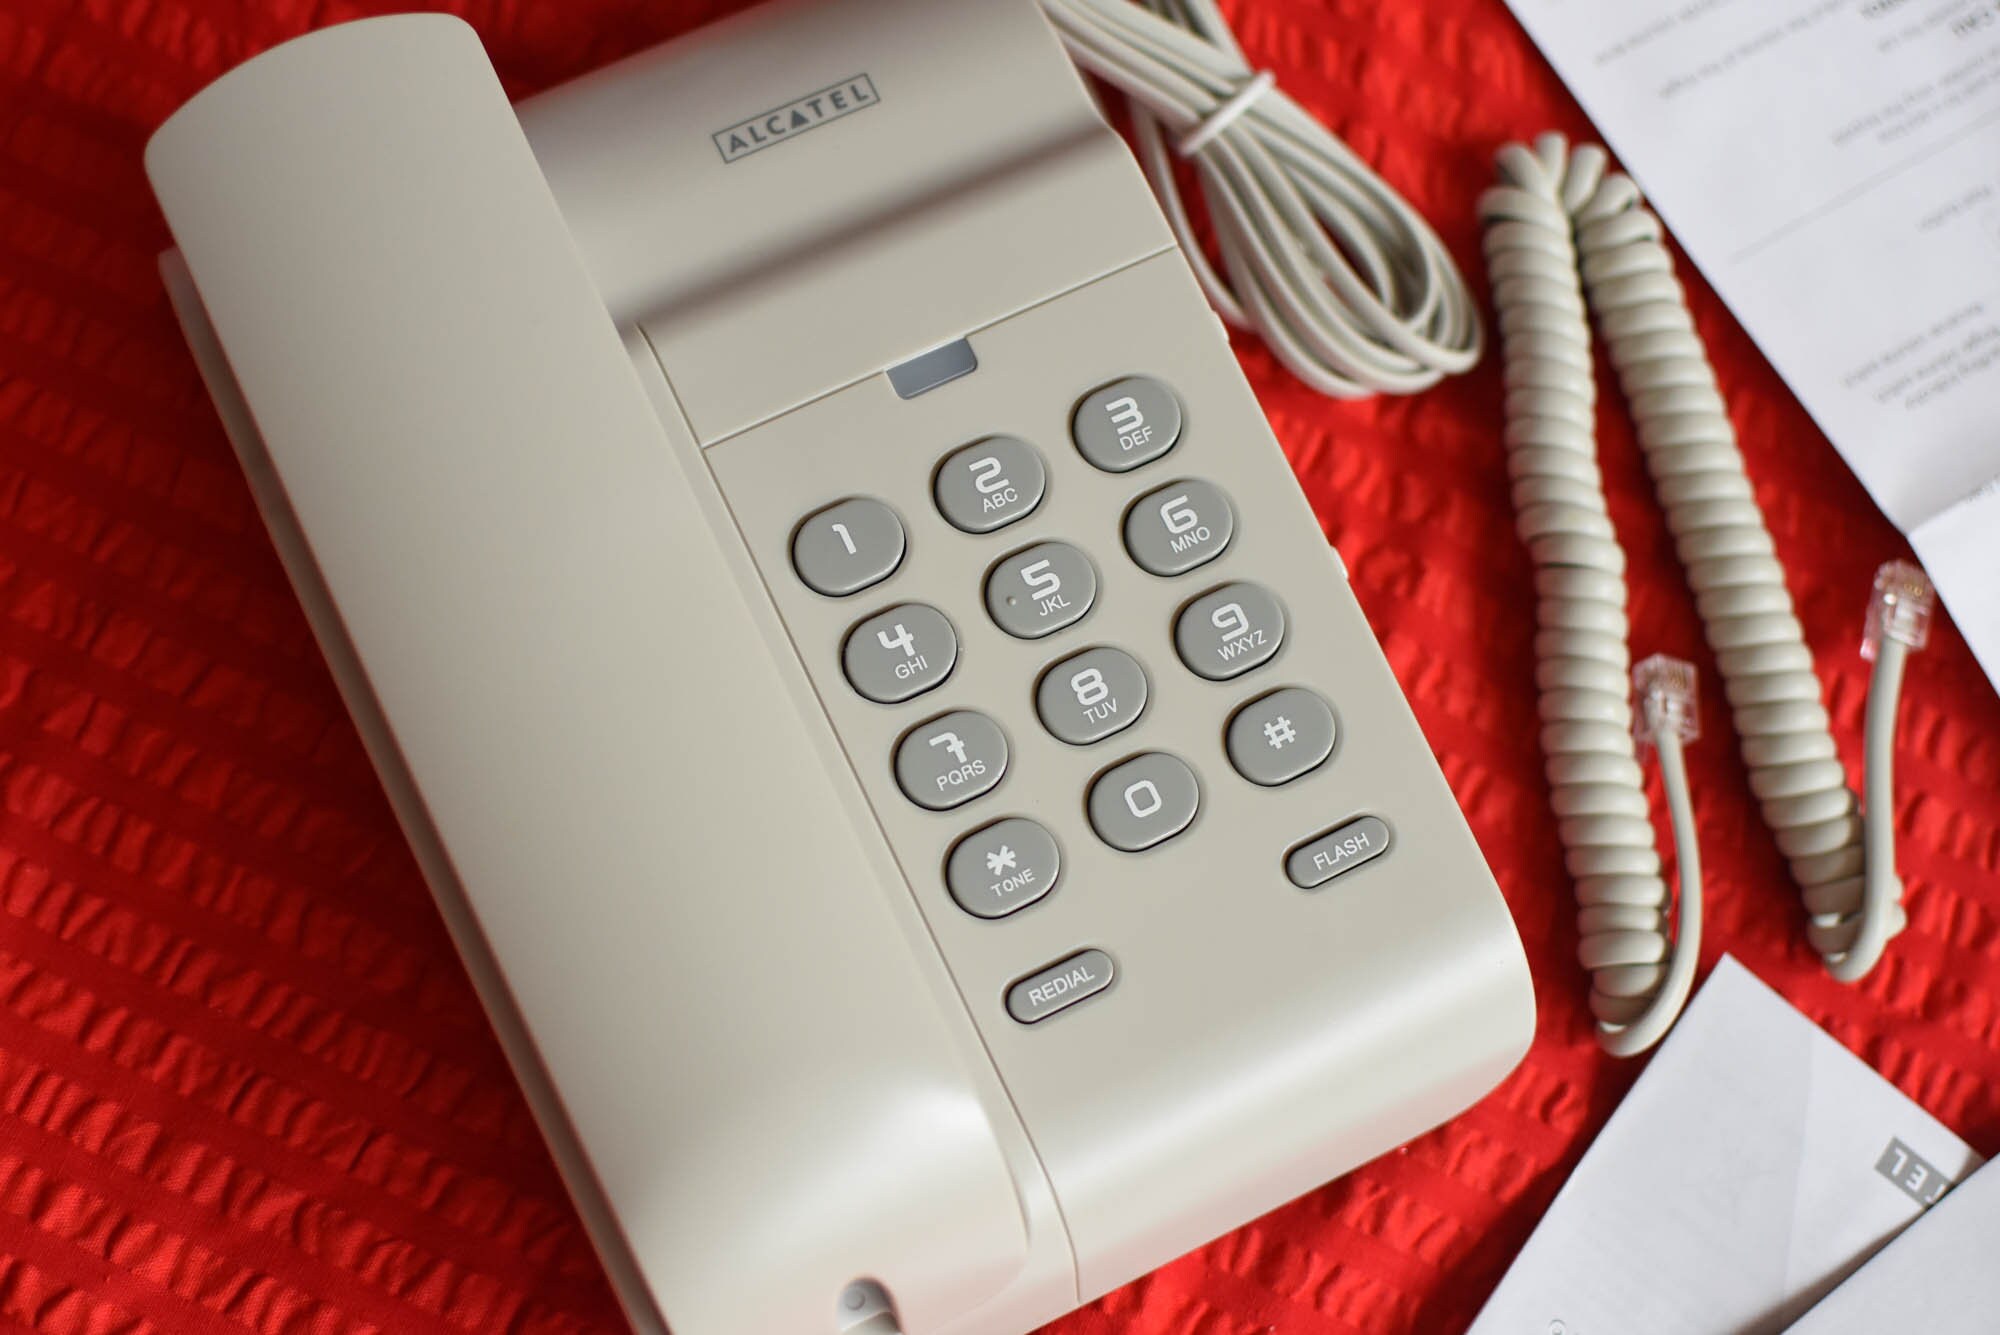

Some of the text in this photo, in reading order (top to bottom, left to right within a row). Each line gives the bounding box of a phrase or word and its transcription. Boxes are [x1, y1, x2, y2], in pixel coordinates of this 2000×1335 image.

[729, 84, 870, 153] ALCATEL
[1106, 397, 1143, 434] 3
[1120, 426, 1153, 451] DEF
[969, 457, 1010, 494] 2
[983, 488, 1018, 513] ABC
[1160, 495, 1198, 534] 6
[832, 523, 857, 555] 1
[1170, 527, 1210, 553] MNO
[1021, 559, 1061, 601] 5
[1039, 595, 1071, 617] JKL
[1211, 603, 1249, 642] 9
[877, 623, 916, 657] 4
[1217, 630, 1267, 661] WXYZ
[894, 655, 928, 679] GHI
[1070, 668, 1109, 706] 8
[1083, 698, 1118, 724] TUV
[929, 732, 967, 763] 7
[936, 760, 986, 791] PQRS
[1313, 833, 1370, 871] FLASH
[990, 869, 1035, 897] TONE
[1028, 966, 1096, 1007] REDIAL
